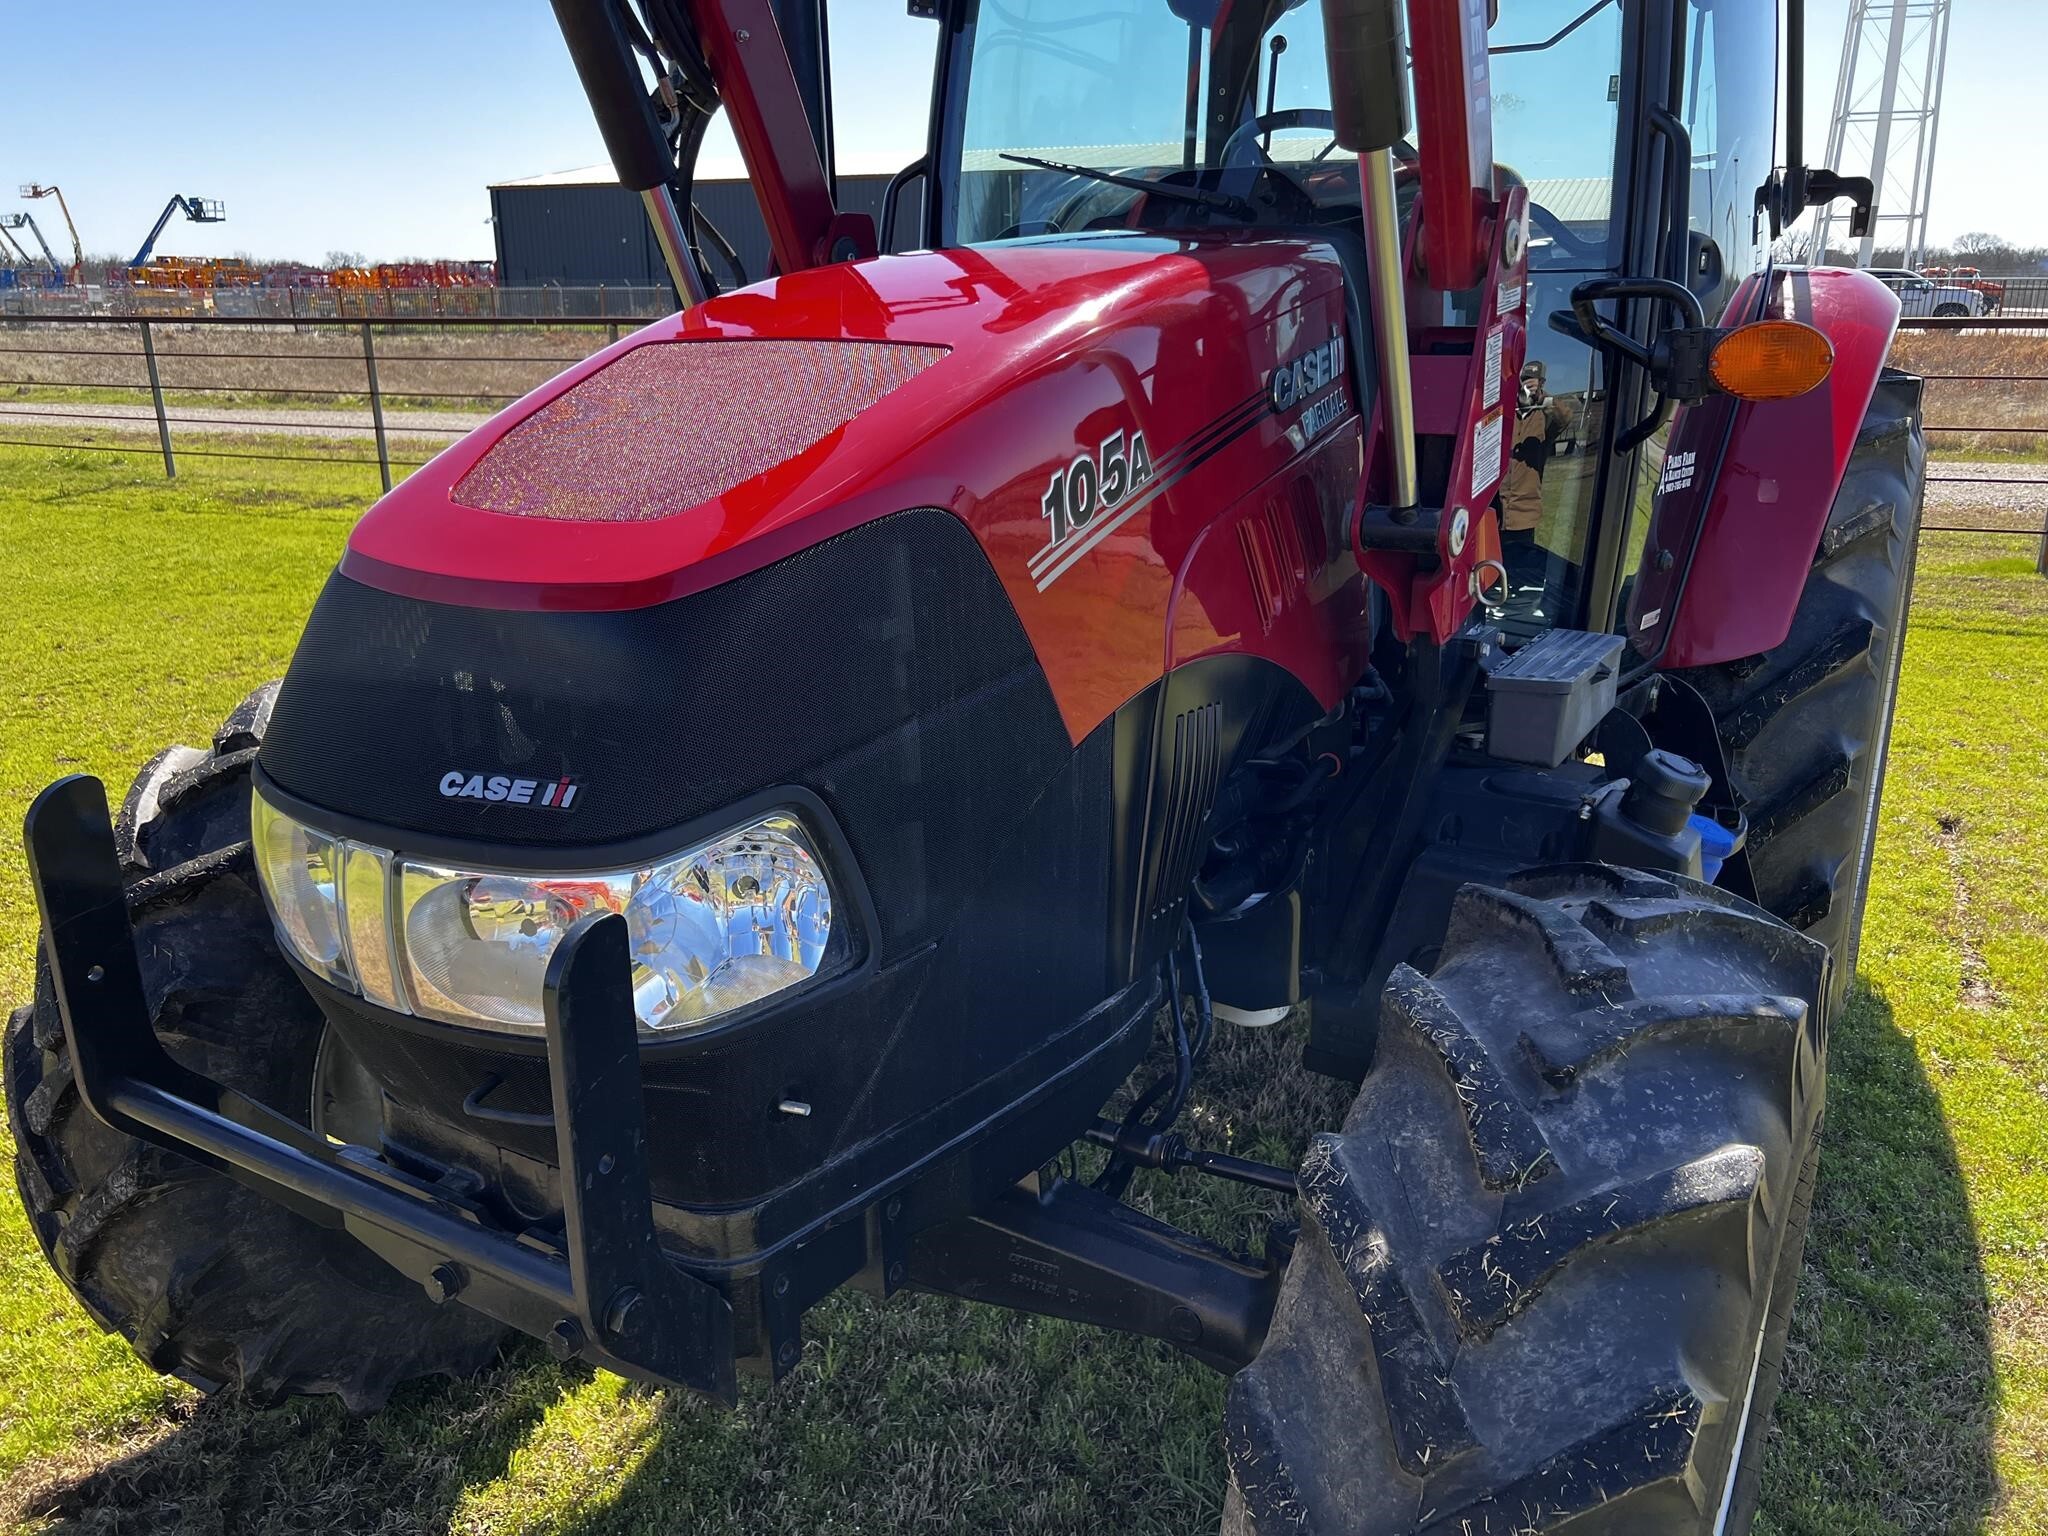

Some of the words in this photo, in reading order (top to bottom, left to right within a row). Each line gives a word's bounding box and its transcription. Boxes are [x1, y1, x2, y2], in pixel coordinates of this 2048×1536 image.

[1274, 343, 1331, 412] CASE
[1302, 386, 1348, 441] FARMALL
[1041, 428, 1153, 548] 105A
[439, 771, 538, 804] CASE
